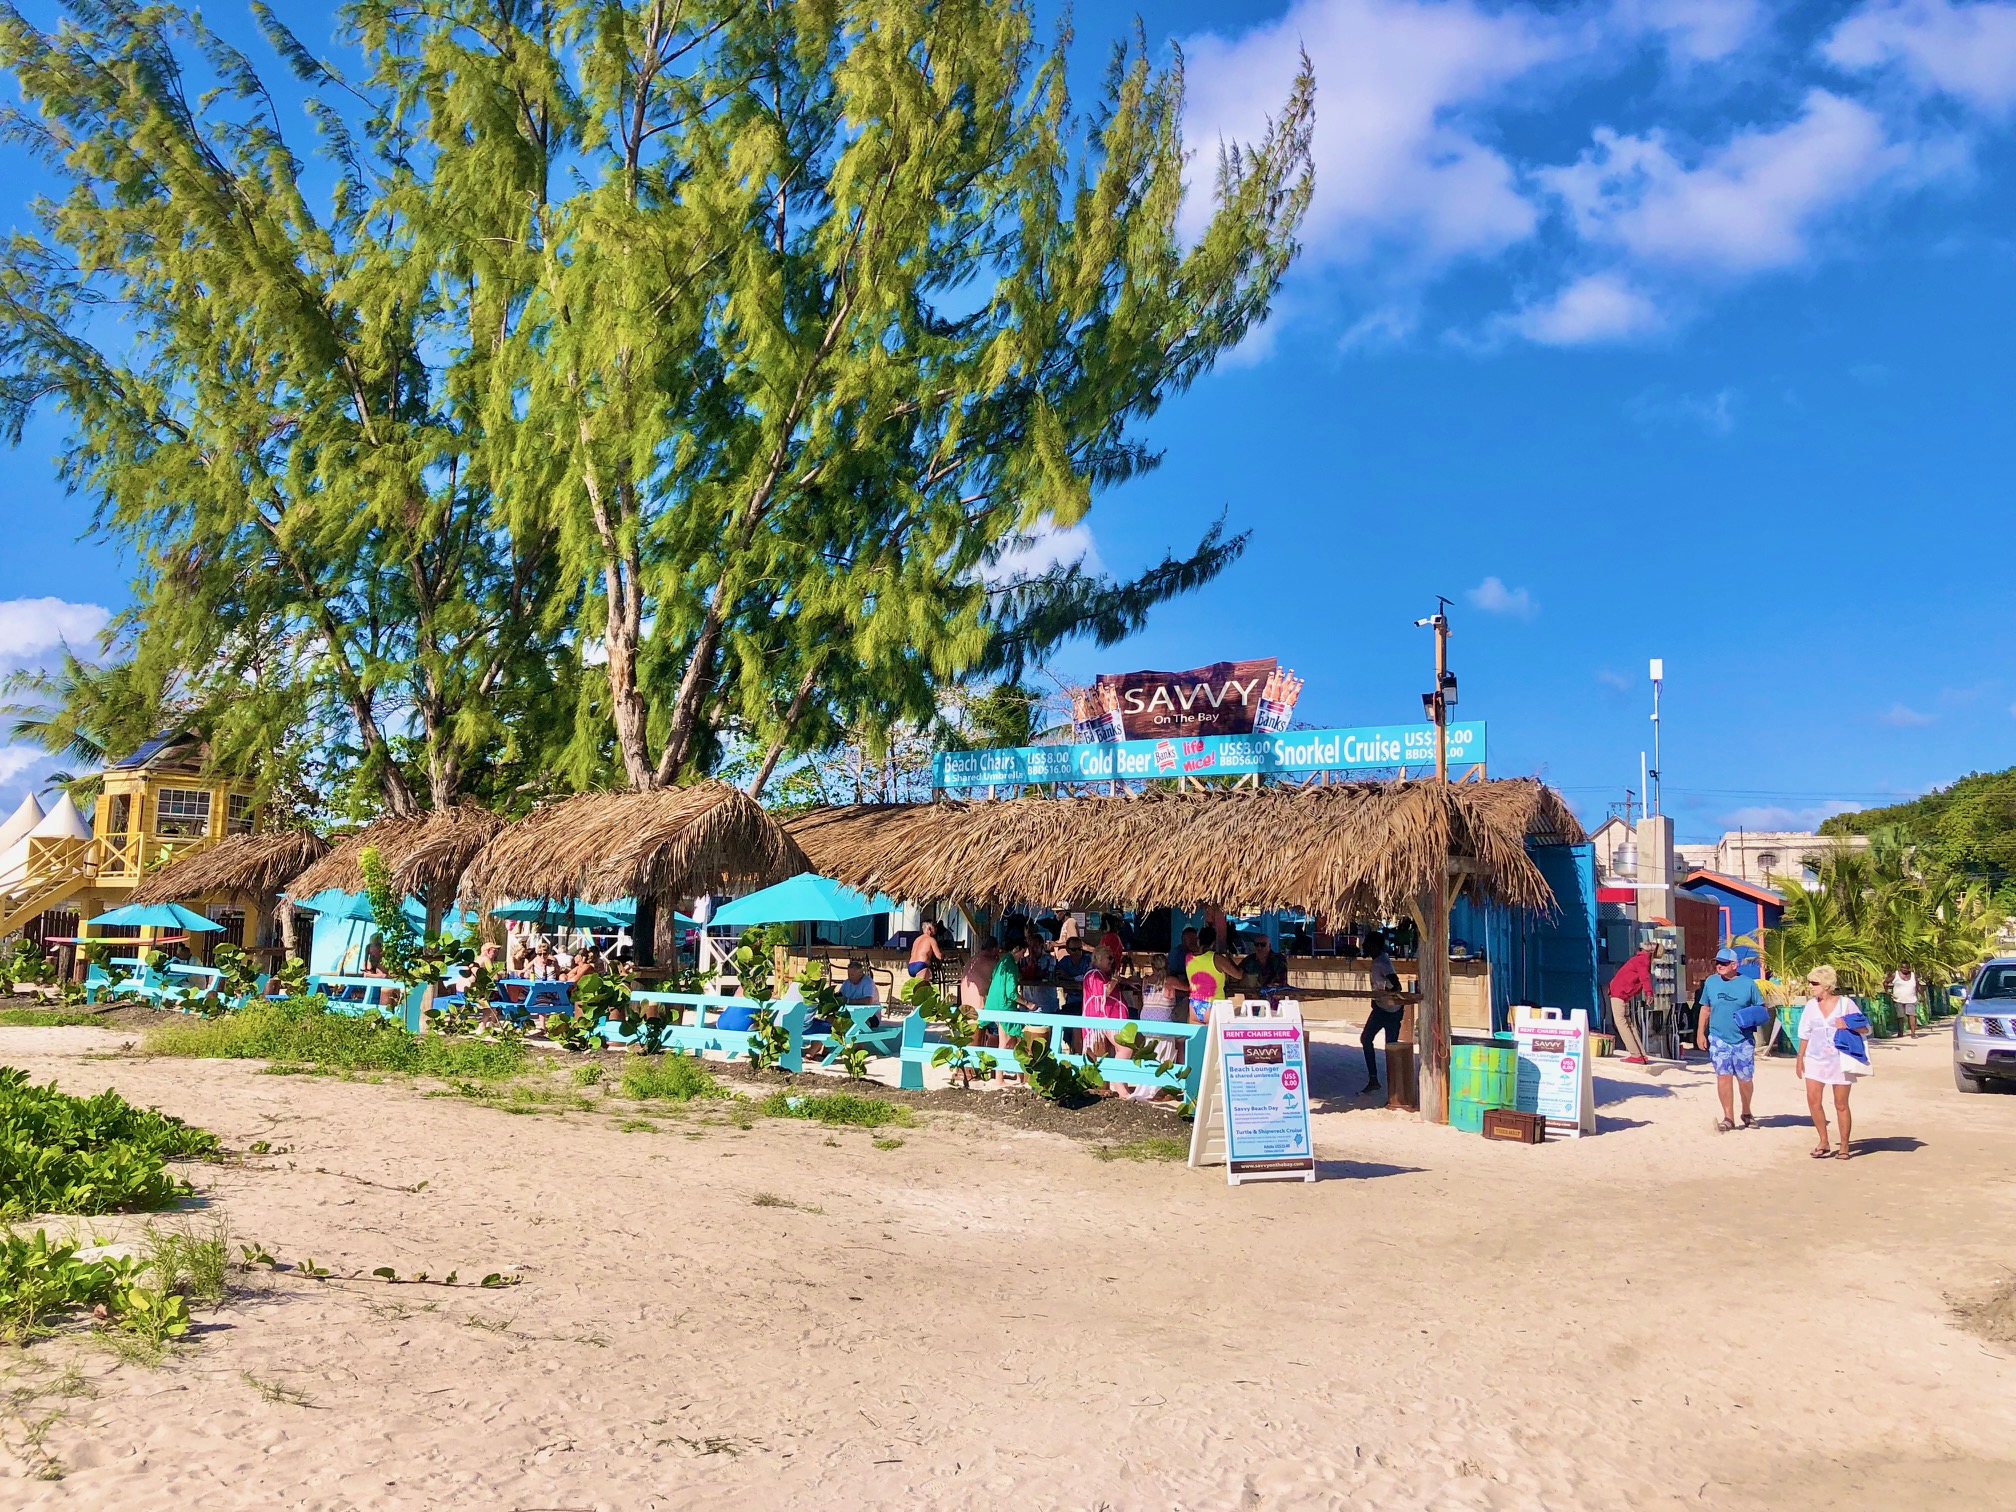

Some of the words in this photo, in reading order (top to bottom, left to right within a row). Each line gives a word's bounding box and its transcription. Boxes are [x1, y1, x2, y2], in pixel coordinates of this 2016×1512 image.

[1124, 679, 1259, 714] SAVVY
[1153, 715, 1171, 725] On
[1173, 714, 1195, 724] The
[1197, 712, 1220, 725] Bay
[1183, 740, 1204, 756] life
[1219, 740, 1271, 756] US$3.00
[1274, 734, 1340, 767] Snorkel
[1344, 733, 1400, 764] Cruise
[1405, 746, 1464, 760] BBD$.00
[944, 754, 977, 773] Beach
[980, 752, 1015, 771] Chairs
[1027, 751, 1070, 765] US$8.00
[1080, 749, 1113, 775] Cold
[1116, 749, 1152, 773] Beer
[1155, 749, 1177, 764] Banks
[1183, 750, 1216, 772] nice!
[1219, 754, 1265, 767] BBD$6.00
[944, 774, 951, 783] &
[952, 772, 981, 782] Shared
[983, 770, 1023, 781] Umbrella
[1027, 764, 1072, 775] BBD$16.00
[1534, 1040, 1561, 1048] SAVVY
[1246, 1048, 1278, 1056] SAVVY
